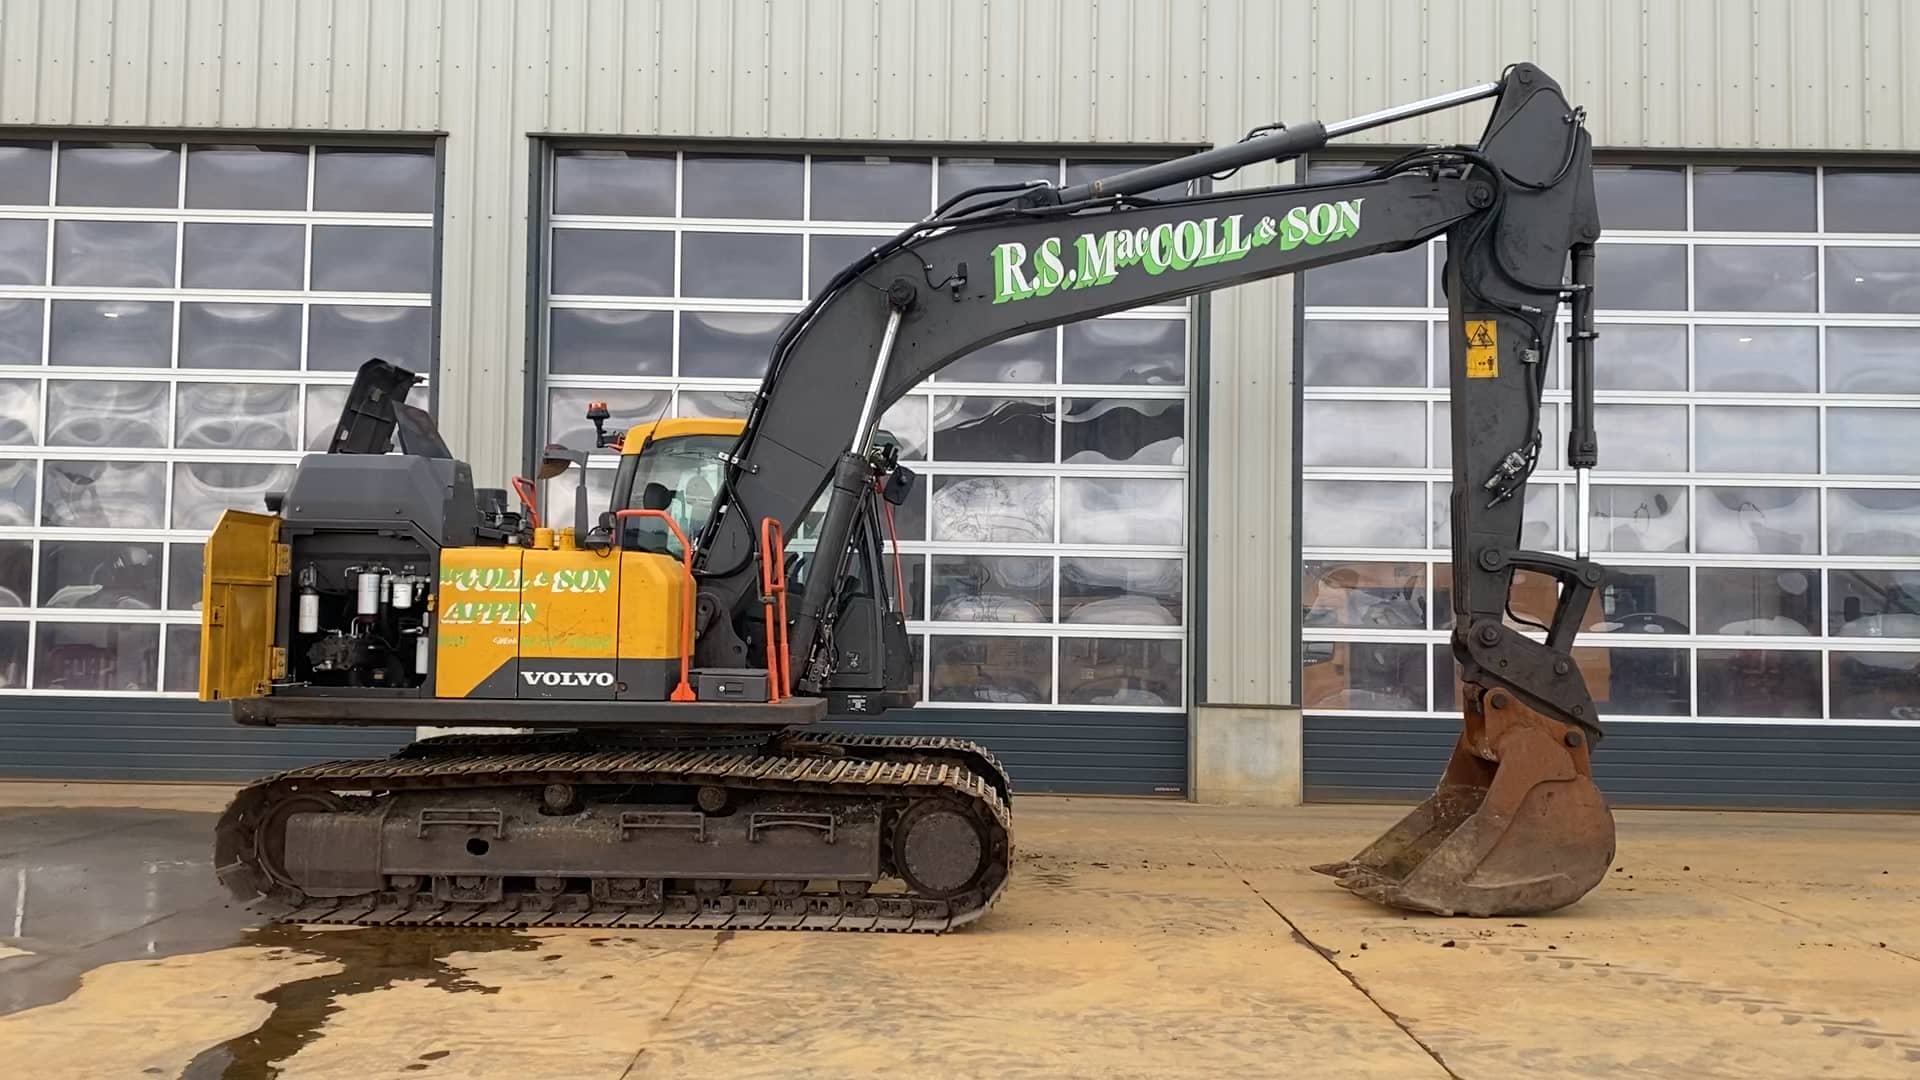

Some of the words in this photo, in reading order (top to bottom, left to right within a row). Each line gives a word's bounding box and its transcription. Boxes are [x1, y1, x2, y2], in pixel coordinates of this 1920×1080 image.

[1252, 216, 1277, 247] &
[1280, 198, 1365, 250] SON
[520, 671, 614, 686] VOLVO
